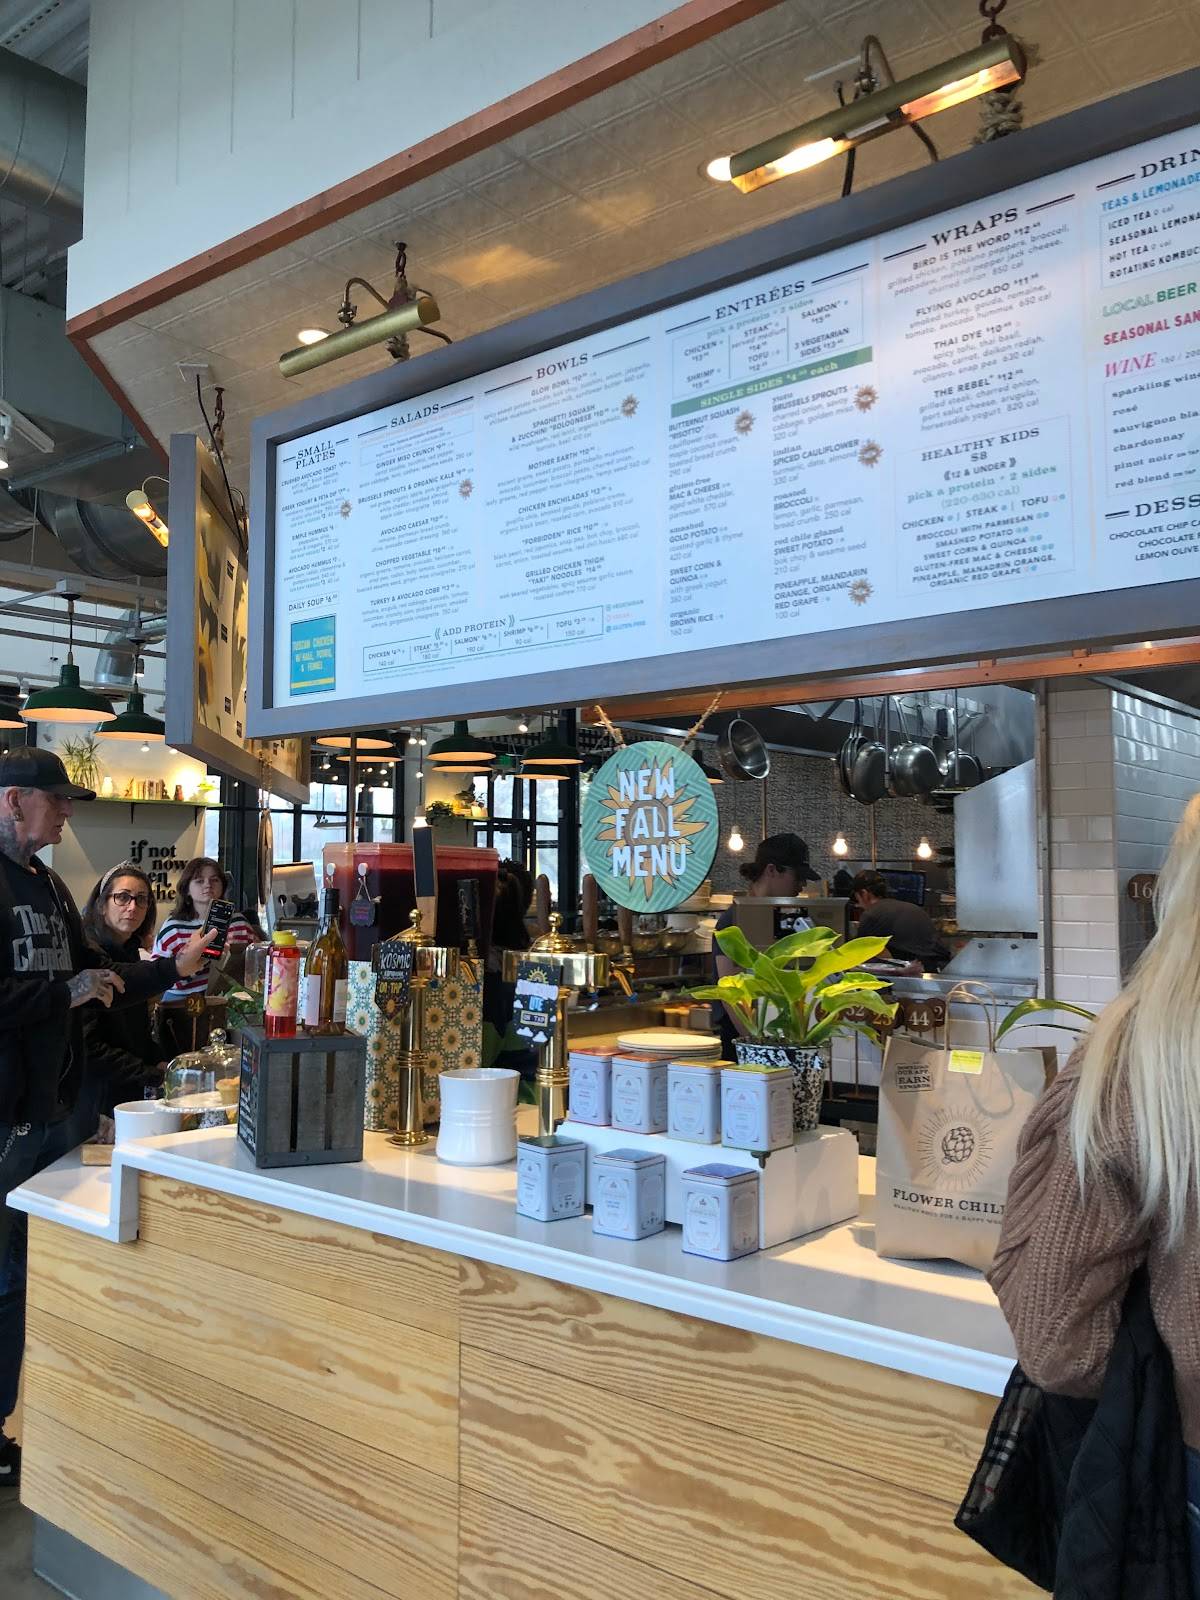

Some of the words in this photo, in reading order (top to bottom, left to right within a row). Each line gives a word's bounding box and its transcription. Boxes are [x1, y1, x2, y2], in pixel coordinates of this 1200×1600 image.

[1102, 195, 1127, 211] TEAS
[932, 207, 1018, 246] WRAPS
[1108, 217, 1129, 230] ICED
[1133, 210, 1150, 222] TEA
[1109, 225, 1158, 245] SEASONAL
[912, 256, 936, 270] BIRD
[952, 245, 972, 257] THE
[976, 233, 1010, 249] WORD
[1109, 250, 1126, 262] HOT
[1131, 244, 1148, 256] TEA
[1109, 259, 1155, 278] ROTATING
[715, 277, 805, 319] ENTRÉES
[916, 300, 951, 316] FLYING
[956, 282, 1009, 304] AVOCADO
[1157, 282, 1196, 302] BEER
[934, 337, 957, 349] THAI
[962, 330, 982, 342] DYE
[1103, 318, 1170, 344] SEASONAL
[684, 340, 716, 356] CHICKEN
[537, 353, 587, 378] BOWLS
[1105, 352, 1156, 376] WINE
[700, 388, 740, 407] SINGLE
[746, 376, 783, 394] SIDES
[934, 385, 953, 397] THE
[1112, 379, 1170, 397] sparkling
[391, 404, 438, 426] SALADS
[1113, 416, 1176, 434] sauvignon
[297, 440, 333, 458] SMALL
[921, 438, 994, 460] HEALTHY
[999, 428, 1039, 443] KIDS
[1113, 432, 1184, 452] chardonnay
[295, 449, 335, 468] PLATES
[528, 458, 554, 470] MOTHER
[556, 451, 577, 462] EARTH
[973, 461, 1005, 474] UNDER
[1114, 459, 1143, 471] pinot
[1148, 453, 1173, 465] noir
[1115, 478, 1133, 488] red
[1138, 472, 1169, 484] blend
[518, 502, 545, 514] CHICKEN
[548, 491, 587, 506] ENCHILADAS
[1021, 495, 1048, 507] TOFU
[966, 505, 997, 518] STEAK
[566, 526, 581, 536] RICE
[902, 516, 943, 530] CHICKEN
[916, 529, 957, 541] BROCCOLI
[960, 524, 981, 533] WITH
[985, 515, 1033, 529] PARMESAN
[1109, 526, 1163, 540] CHOCOLATE
[1166, 521, 1188, 531] CHIP
[935, 536, 976, 548] SMASHED
[979, 528, 1013, 540] POTATO
[1138, 534, 1193, 548] CHOCOLATE
[923, 550, 950, 560] SWEET
[953, 545, 977, 555] CORN
[990, 537, 1026, 549] QUINOA
[972, 553, 991, 562] MAC
[1004, 545, 1037, 557] CHEESE
[1135, 549, 1168, 561] LEMON
[552, 560, 581, 572] CHICKEN
[288, 601, 305, 611] DAILY
[307, 597, 323, 607] SOUP
[442, 626, 460, 637] ADD
[464, 619, 505, 633] PROTEIN
[618, 767, 675, 802] NEW
[616, 805, 681, 840] FALL
[130, 839, 148, 864] if
[148, 845, 176, 858] not
[612, 844, 686, 878] MENU
[152, 859, 188, 870] now
[1142, 905, 1167, 923] 16
[380, 953, 411, 970] KOSMIC
[910, 1011, 930, 1026] 44
[898, 1076, 930, 1084] EARN
[892, 1188, 954, 1208] FLOWER
